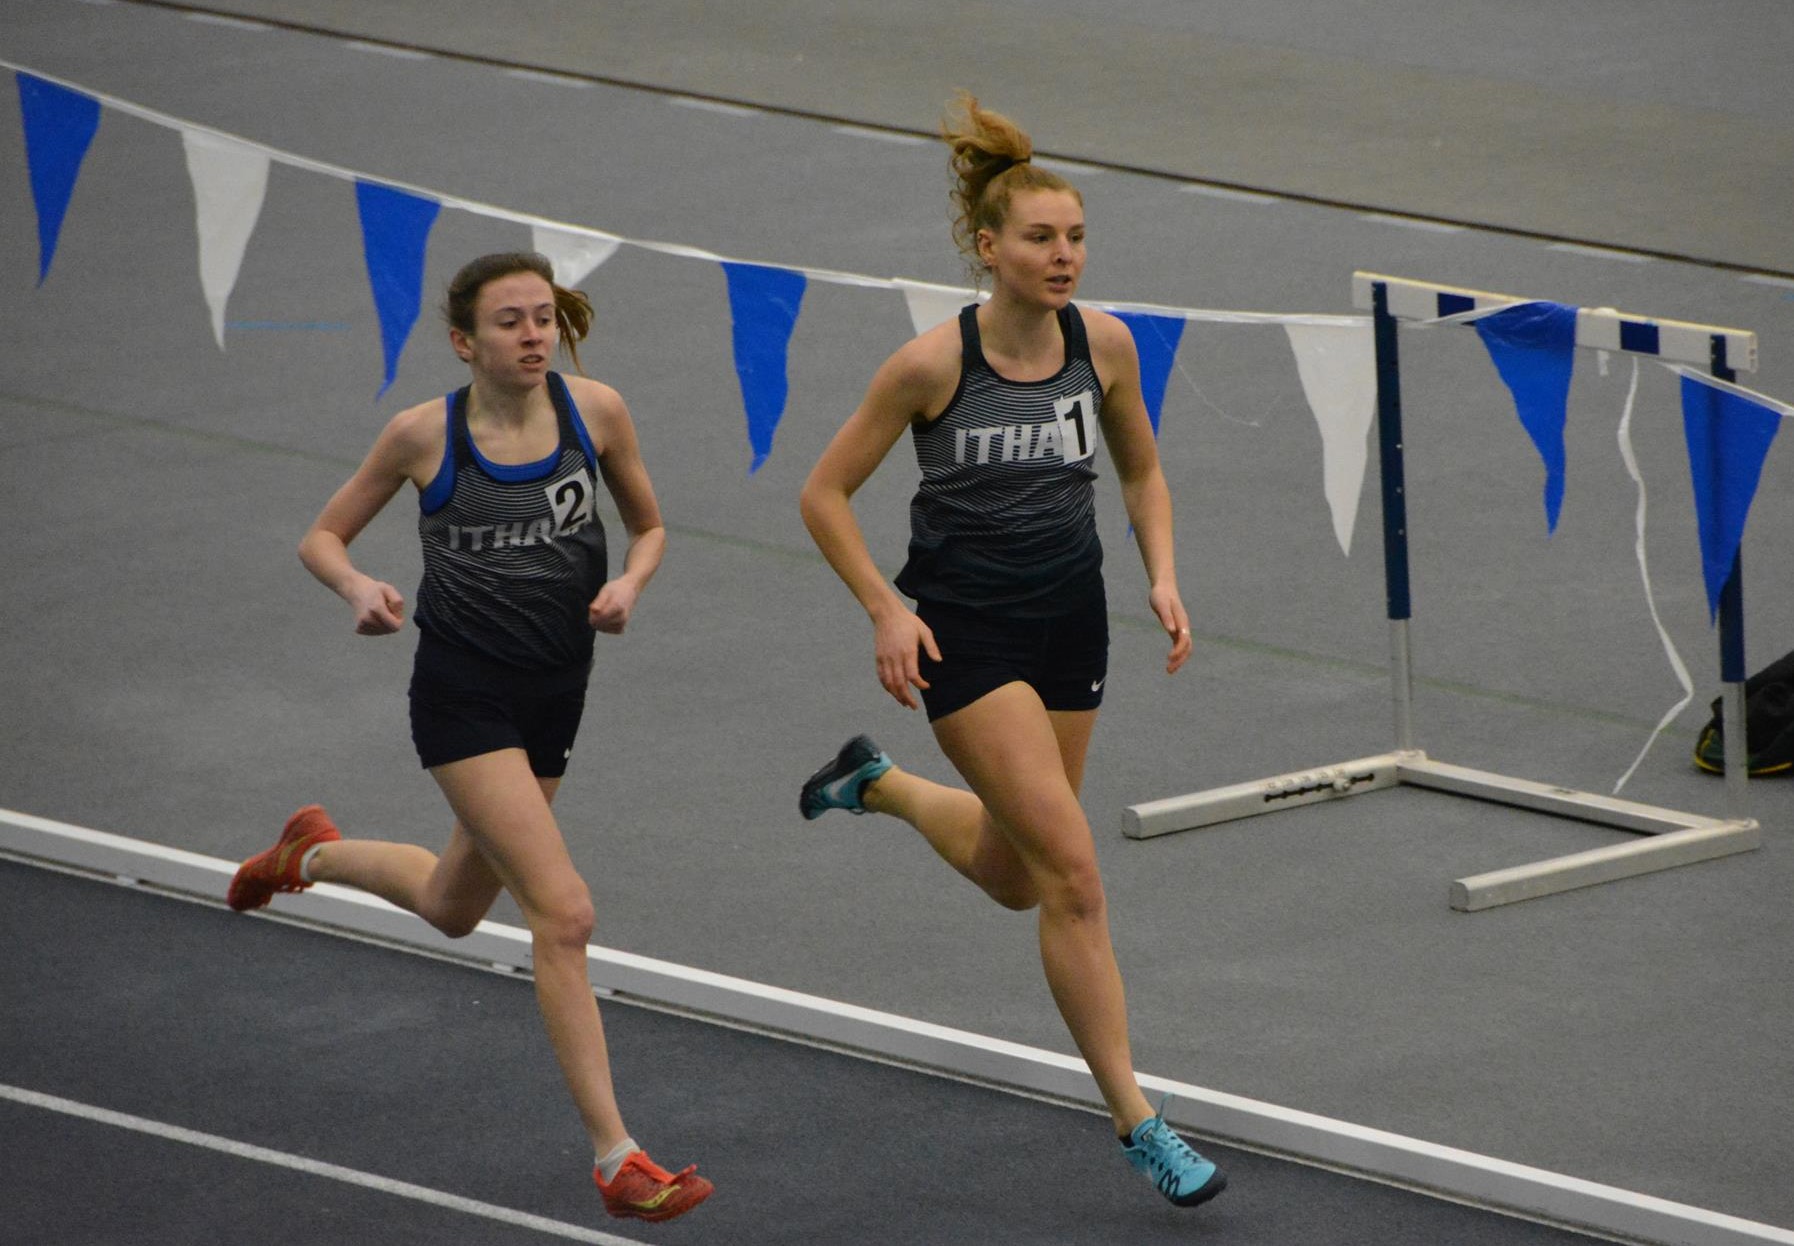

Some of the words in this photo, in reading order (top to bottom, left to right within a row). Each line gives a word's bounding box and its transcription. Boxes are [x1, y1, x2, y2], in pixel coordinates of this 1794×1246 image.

[954, 422, 1064, 465] ITHA
[1064, 400, 1088, 457] 1
[555, 480, 587, 532] 2
[448, 516, 554, 552] ITHA
